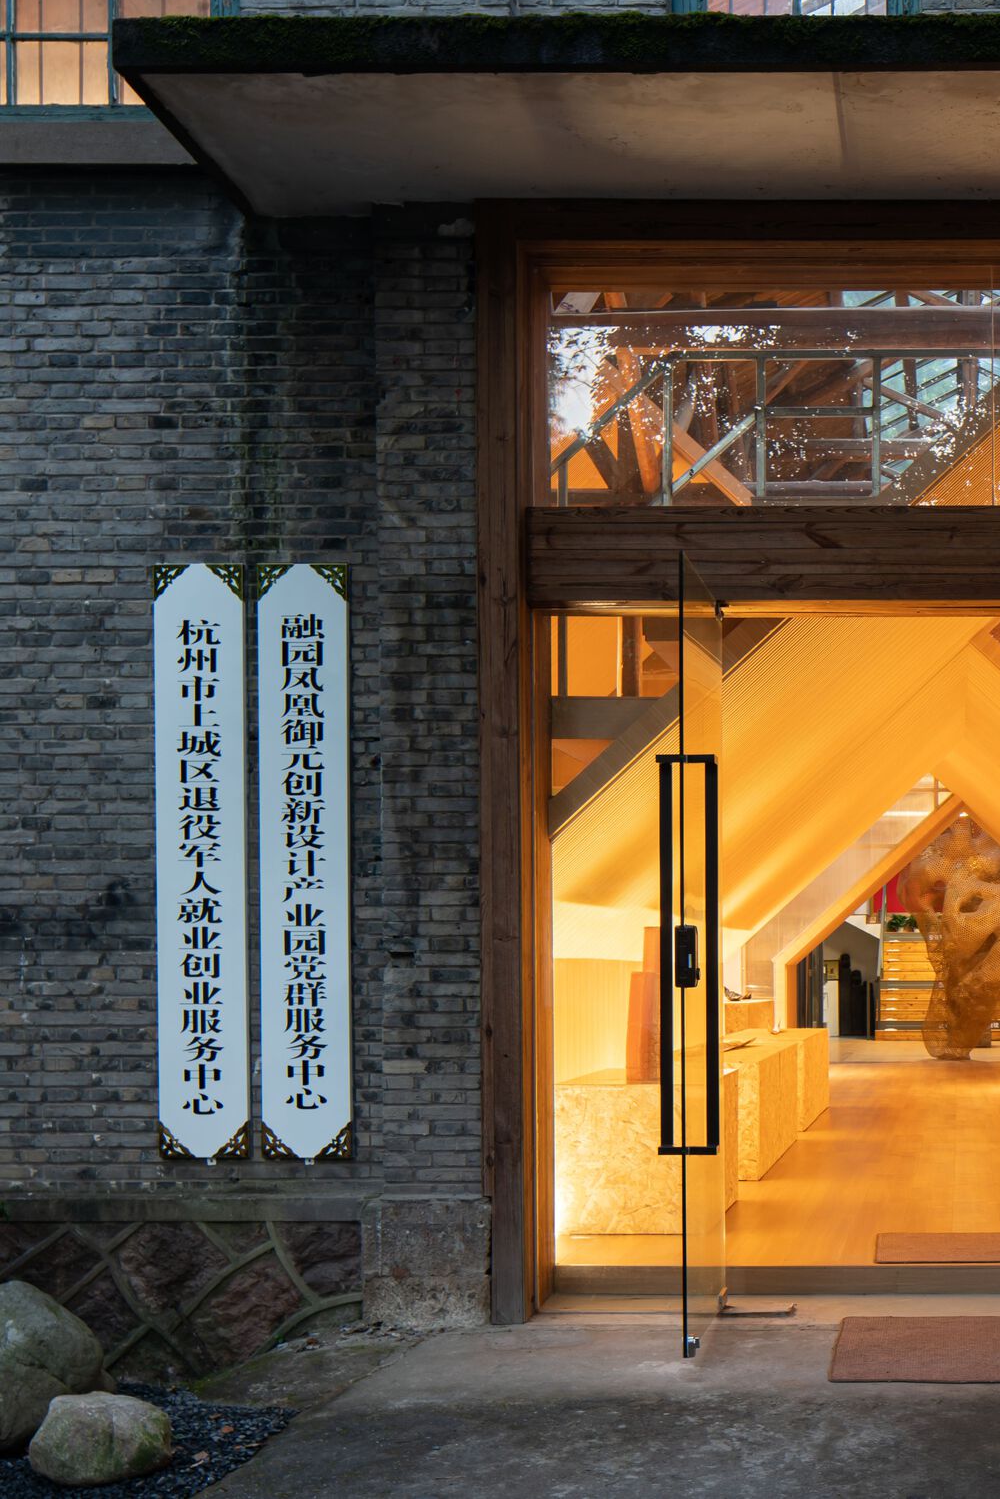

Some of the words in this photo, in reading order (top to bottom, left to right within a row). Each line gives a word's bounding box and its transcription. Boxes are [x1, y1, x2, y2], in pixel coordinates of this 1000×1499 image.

[177, 619, 224, 1116] 杭州市上城区退役军人就业创业服务中心
[280, 613, 328, 1110] 融园凤凰御元创新设计产业园党群服务中心
